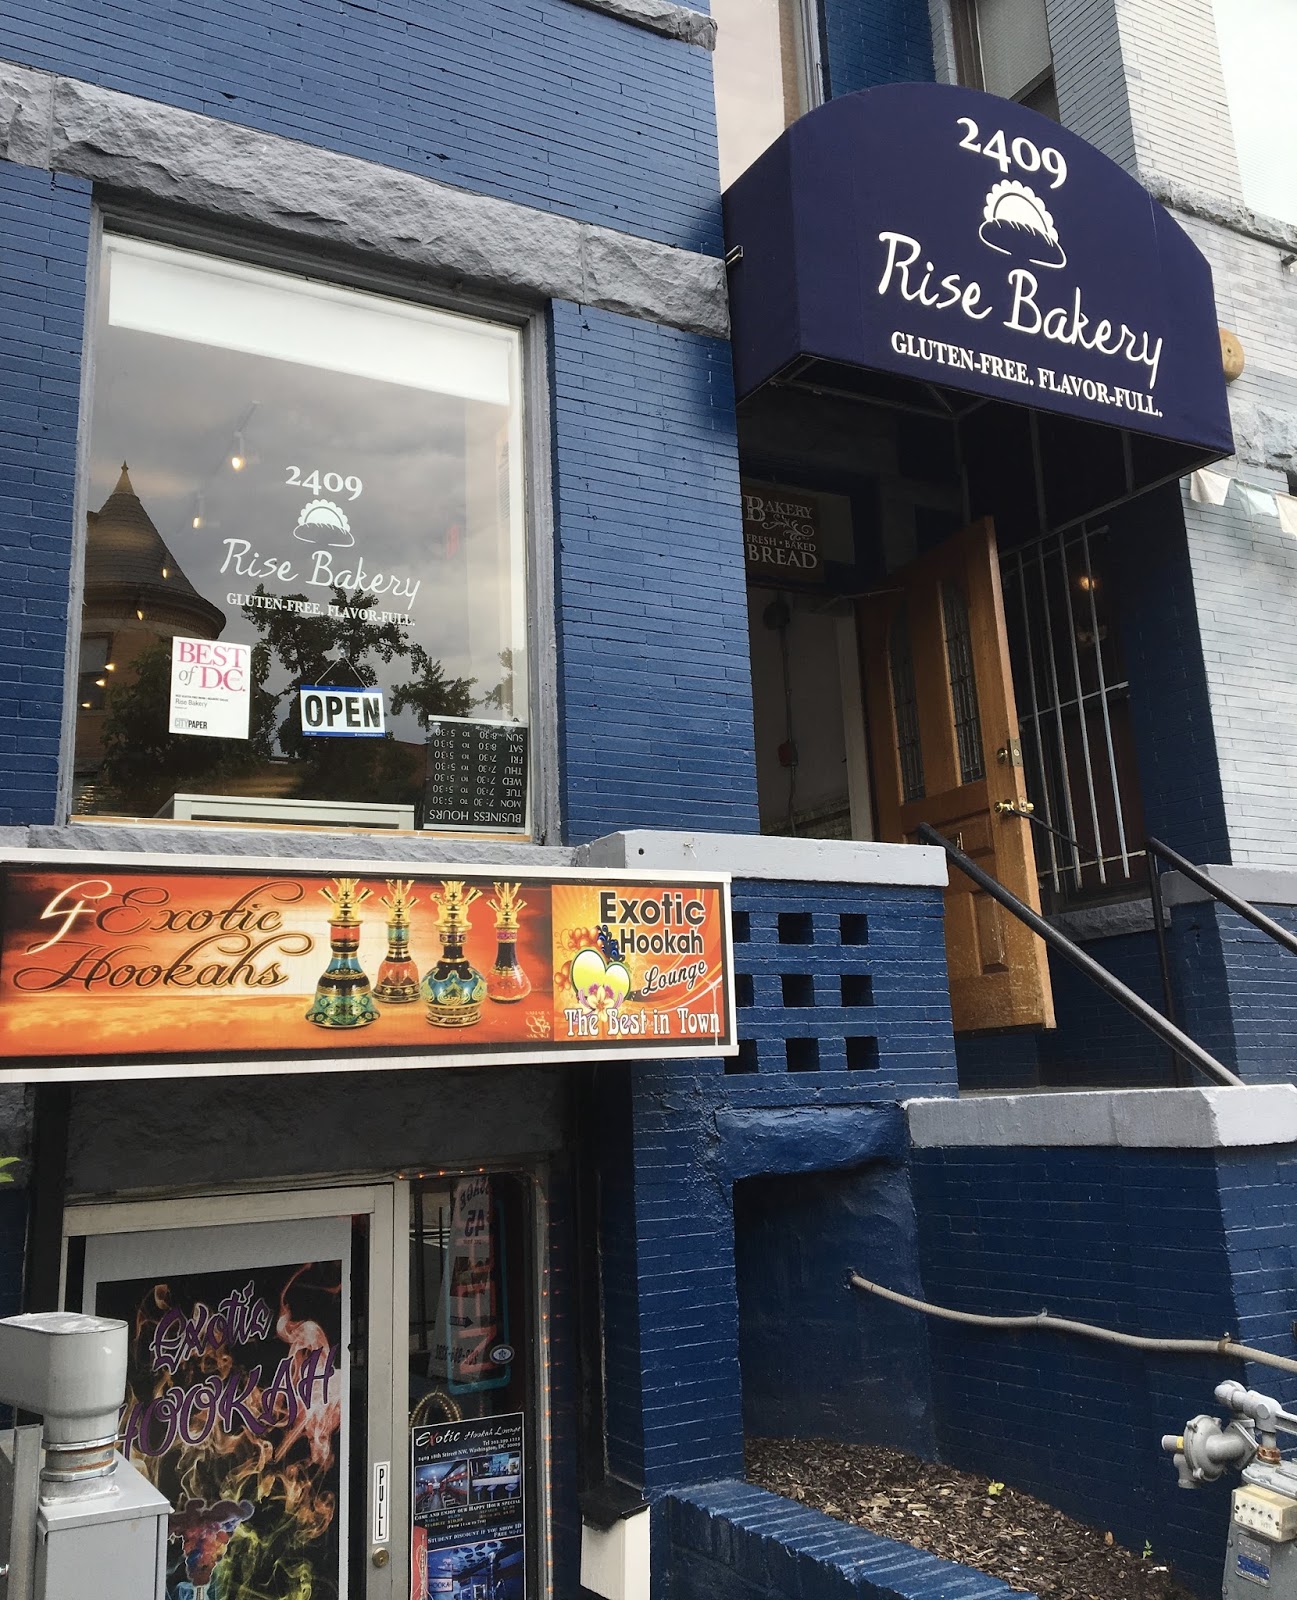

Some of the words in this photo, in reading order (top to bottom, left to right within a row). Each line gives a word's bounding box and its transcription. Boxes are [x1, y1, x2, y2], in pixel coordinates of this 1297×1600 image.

[956, 117, 1068, 189] 2409
[878, 231, 992, 319] Rise
[1003, 269, 1163, 389] Bakery
[891, 330, 1035, 386] GLUTEN-FREE.
[1037, 367, 1164, 418] FLAVOR-FULL.
[285, 466, 363, 501] 2409
[746, 534, 777, 546] FRESH
[785, 541, 816, 552] BAKED
[747, 543, 818, 569] BREAD
[220, 538, 299, 581] Rise
[305, 551, 421, 610] Bakery
[226, 592, 324, 616] GLUTEN-FREE.
[328, 605, 415, 626] FLAVOR-FULL.
[178, 641, 247, 668] BEST
[179, 666, 198, 686] of
[199, 666, 246, 692] D.C.
[188, 699, 208, 708] Bakery
[305, 695, 381, 728] OPEN
[506, 733, 523, 742] SUN
[509, 745, 523, 753] SAT
[504, 767, 523, 775] THU
[510, 756, 523, 764] FRI
[502, 778, 522, 786] WED
[506, 789, 522, 797] TUE
[429, 810, 469, 820] HOURS
[500, 799, 521, 808] MON
[474, 811, 521, 823] BUSINESS
[96, 880, 305, 935] Exotic
[600, 891, 706, 926] Exotic
[619, 928, 704, 955] Hookah
[12, 932, 314, 992] Hookahs
[641, 960, 707, 996] Lounge
[564, 1008, 599, 1036] The
[607, 1008, 646, 1036] Best
[653, 1009, 670, 1034] in
[677, 1008, 720, 1034] Town
[149, 1280, 273, 1375] Exotic
[416, 1430, 460, 1450] Exotic
[464, 1428, 493, 1440] Hookah
[494, 1426, 521, 1436] Lounge
[428, 1535, 452, 1544] STUDENT
[454, 1531, 479, 1539] DISCOUNT
[494, 1530, 507, 1538] FREE
